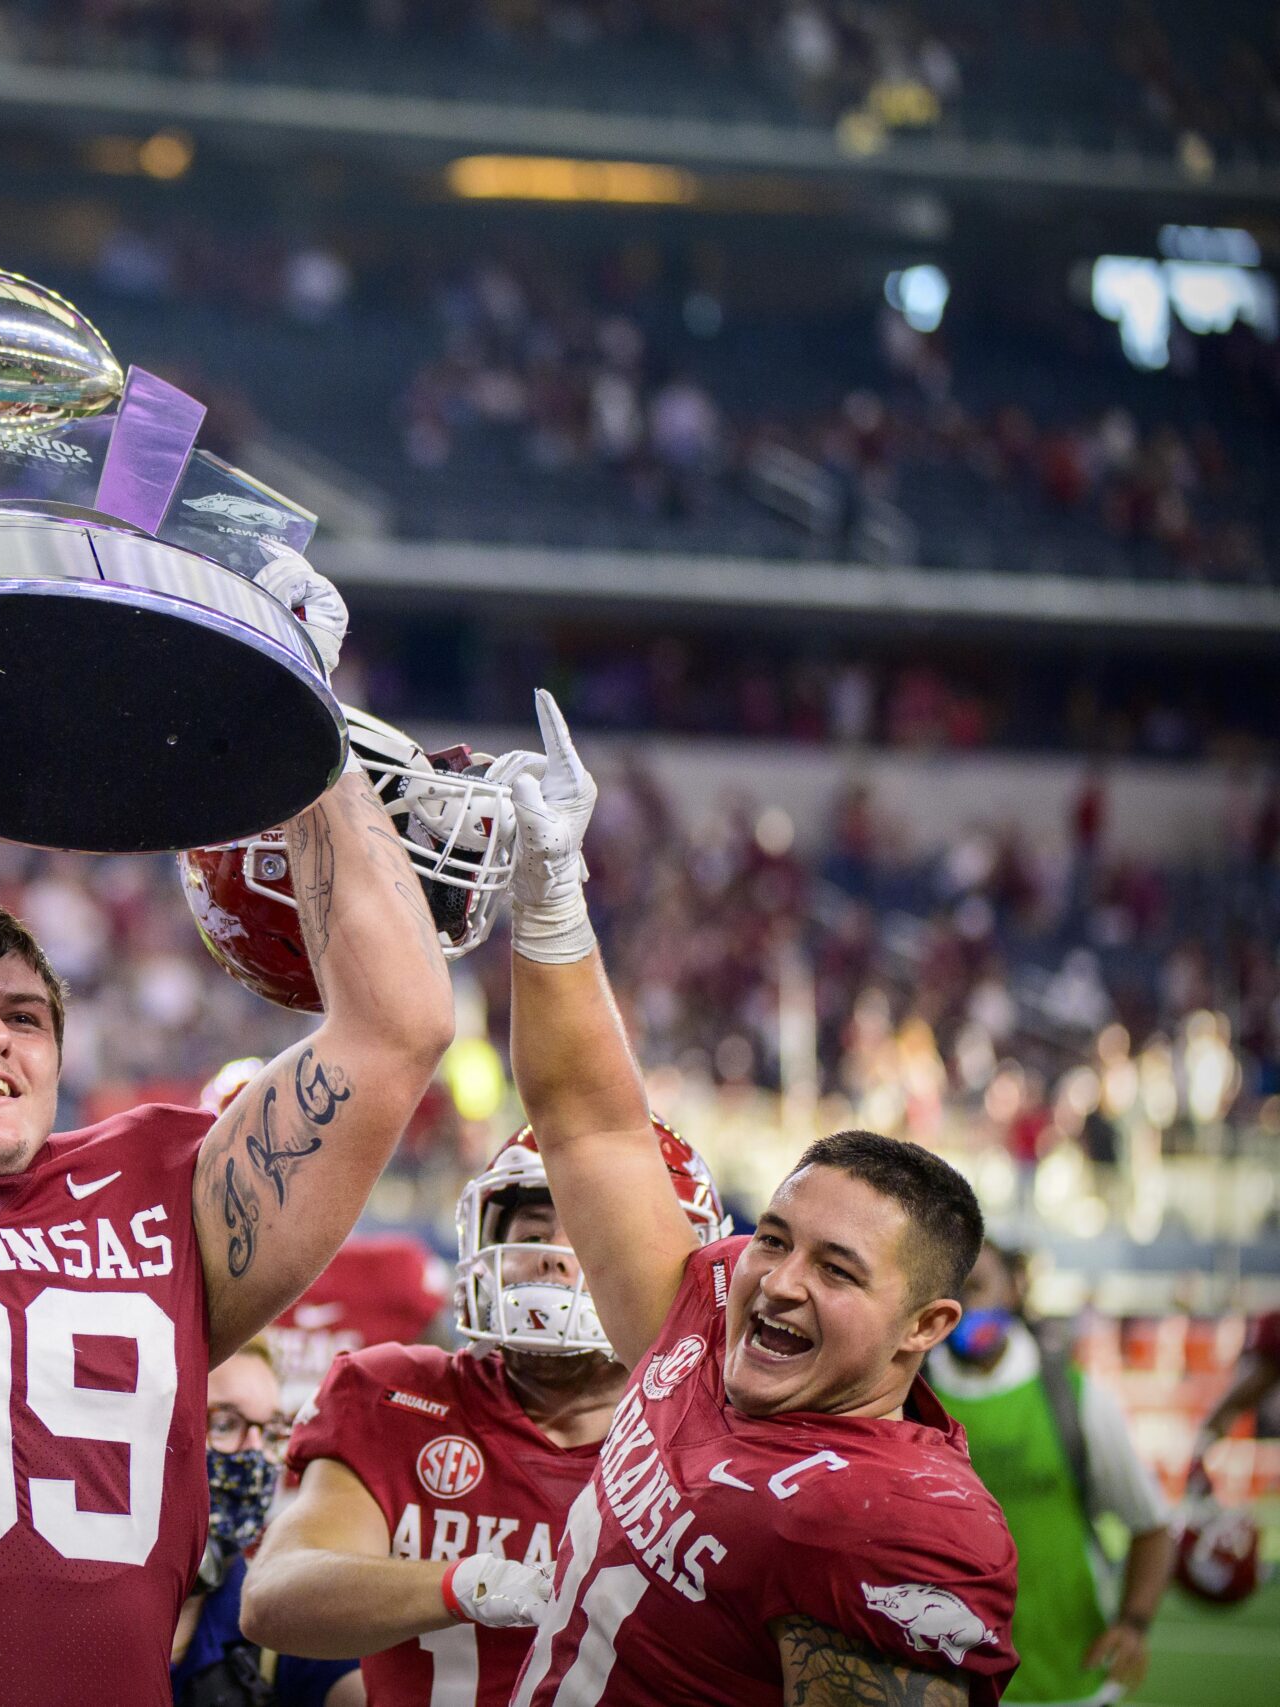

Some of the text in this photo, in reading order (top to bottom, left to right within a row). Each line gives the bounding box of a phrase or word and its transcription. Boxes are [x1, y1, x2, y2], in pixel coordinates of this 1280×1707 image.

[712, 1263, 728, 1309] EQUALITY
[659, 1338, 703, 1384] SEC
[390, 1391, 450, 1417] EQUALITY
[422, 1440, 478, 1493] SEC
[767, 1450, 850, 1500] C
[600, 1382, 728, 1603] ARKANSAS
